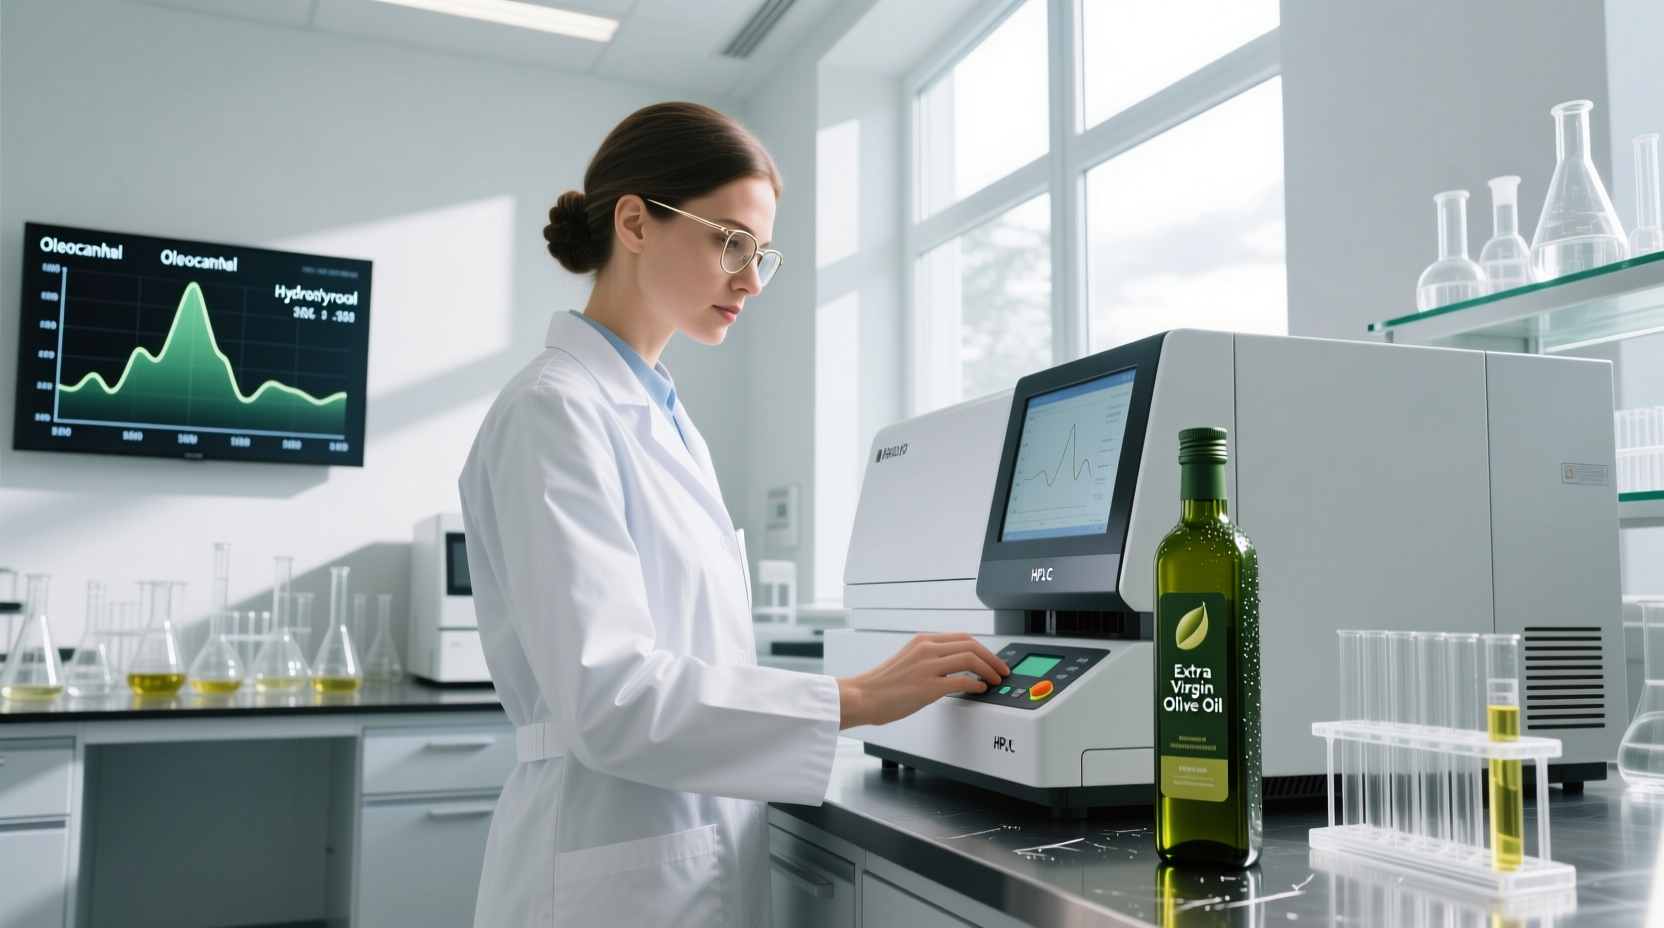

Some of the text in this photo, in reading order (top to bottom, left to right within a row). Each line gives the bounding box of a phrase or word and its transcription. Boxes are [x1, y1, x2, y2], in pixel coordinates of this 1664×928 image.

[1174, 664, 1212, 679] Extra
[1170, 680, 1214, 699] Virgin
[1163, 696, 1223, 713] Olive Oil
